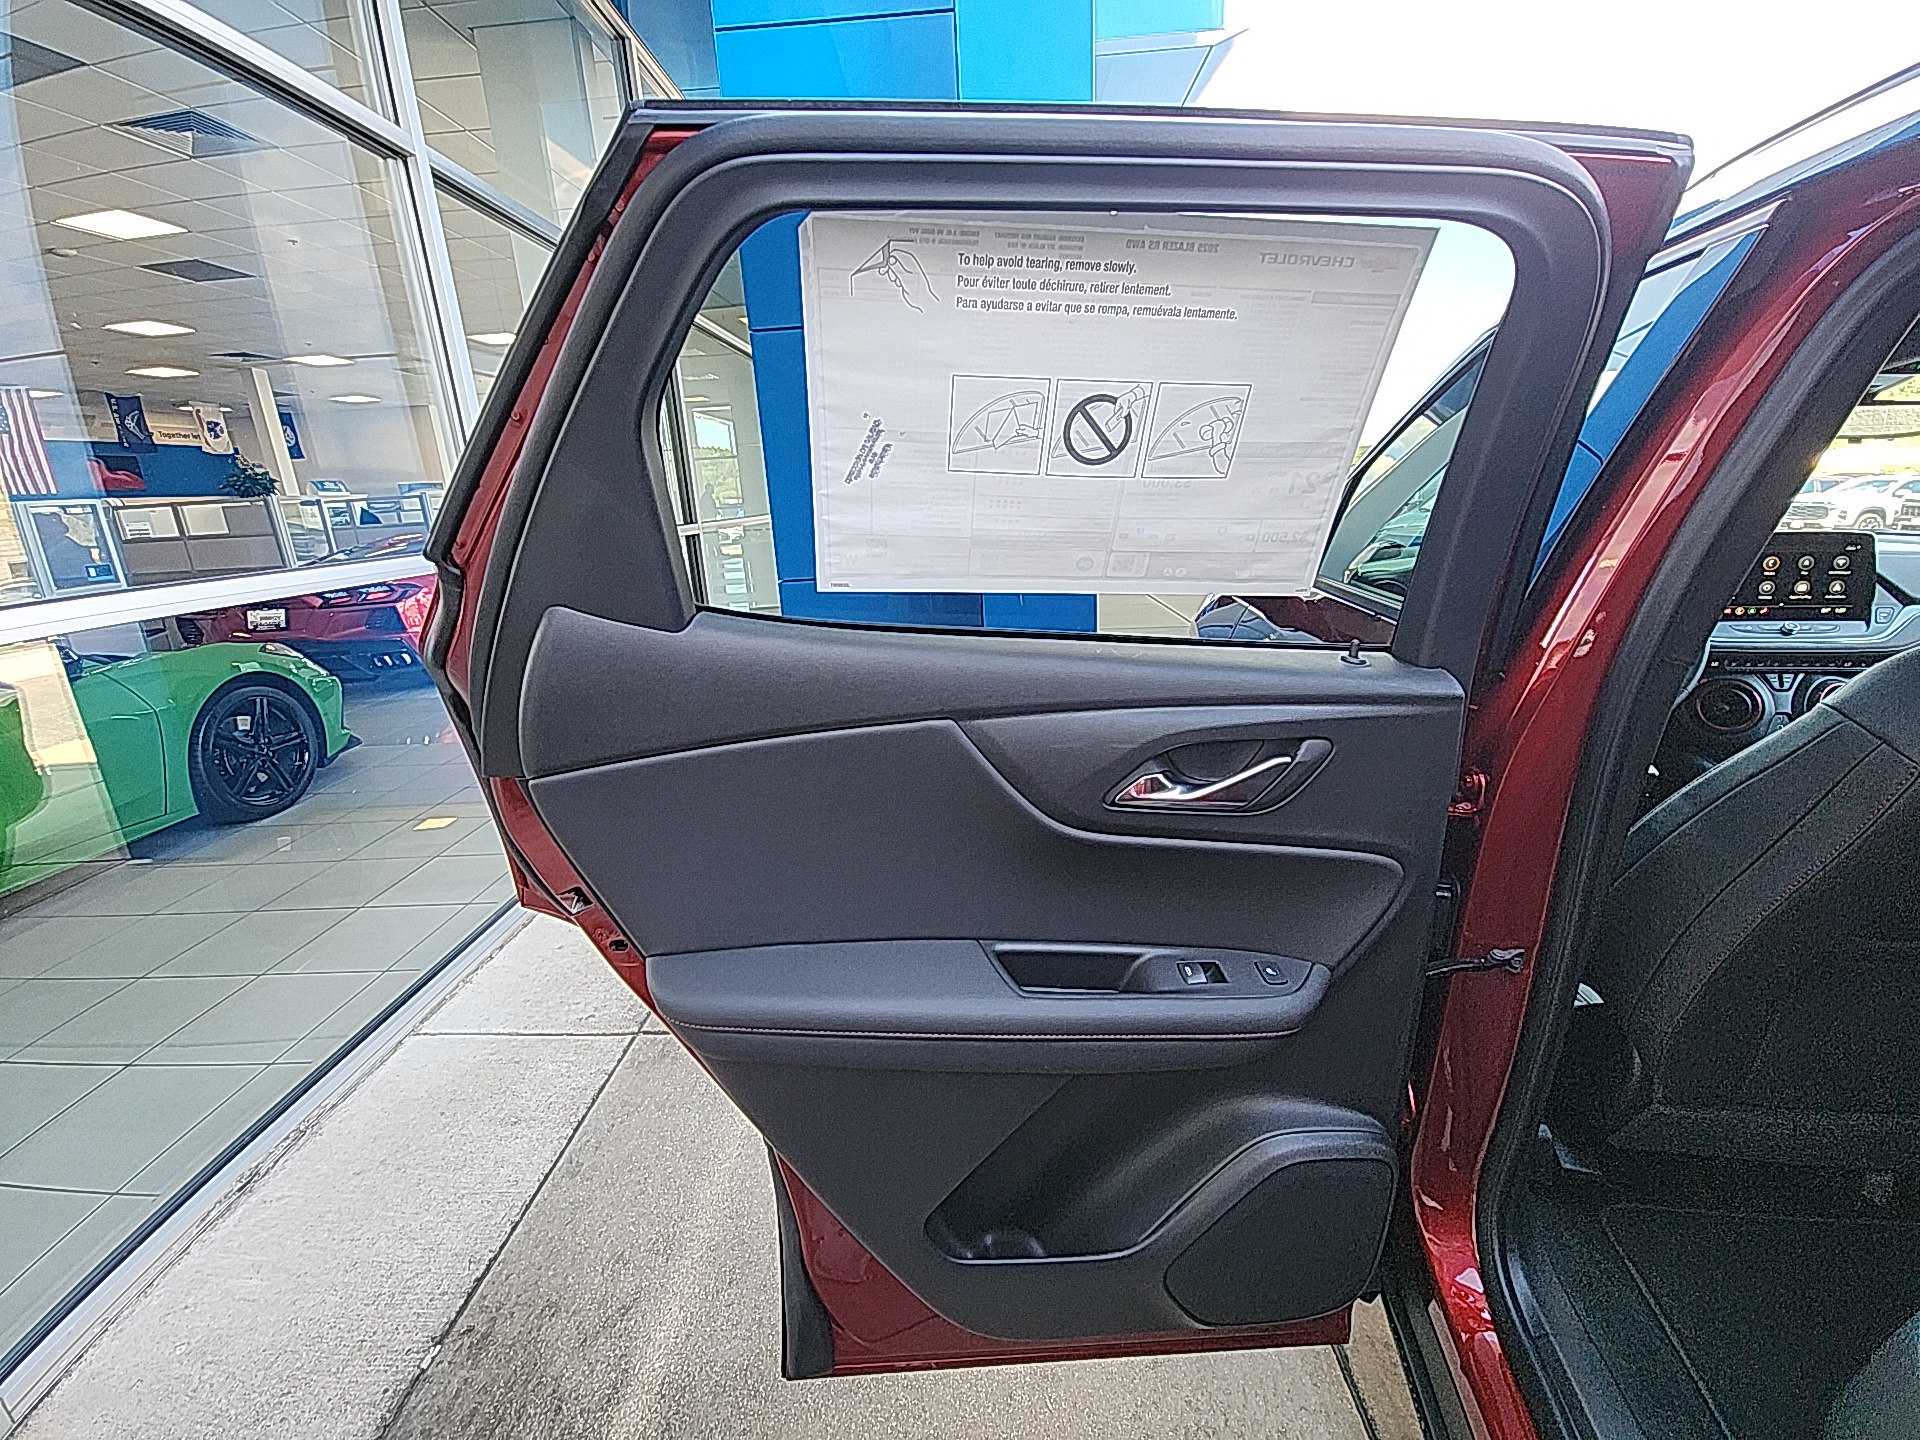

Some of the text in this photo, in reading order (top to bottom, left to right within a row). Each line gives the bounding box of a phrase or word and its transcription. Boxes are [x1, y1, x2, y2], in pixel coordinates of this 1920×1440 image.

[957, 252, 1137, 275] To help avoid tearing, remove slowly.
[957, 275, 1171, 297] Pour éviter toute déchirure, retirer lentement.
[956, 296, 1238, 320] Para ayudarse a evitar que se rompa, remuévala lentamente.
[157, 430, 190, 439] Together
